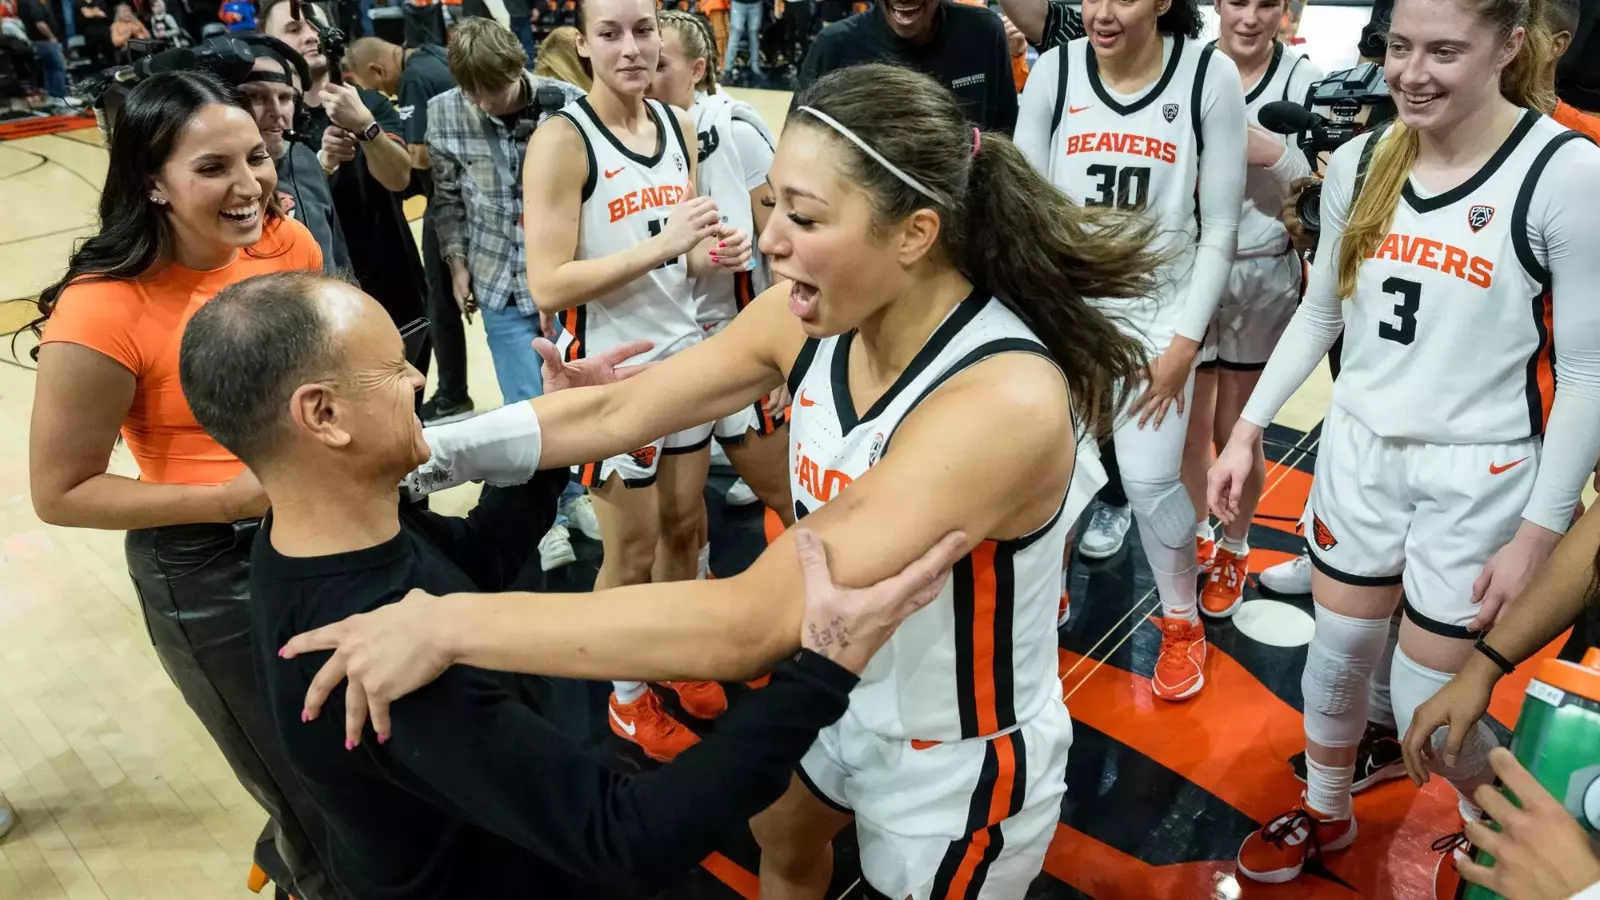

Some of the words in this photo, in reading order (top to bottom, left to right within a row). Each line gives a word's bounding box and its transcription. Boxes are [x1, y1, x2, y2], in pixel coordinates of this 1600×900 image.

[1066, 132, 1177, 164] BEAVERS
[1085, 163, 1151, 212] 30
[1471, 216, 1485, 226] 12
[1364, 233, 1494, 289] AVERS
[1379, 276, 1422, 346] 3
